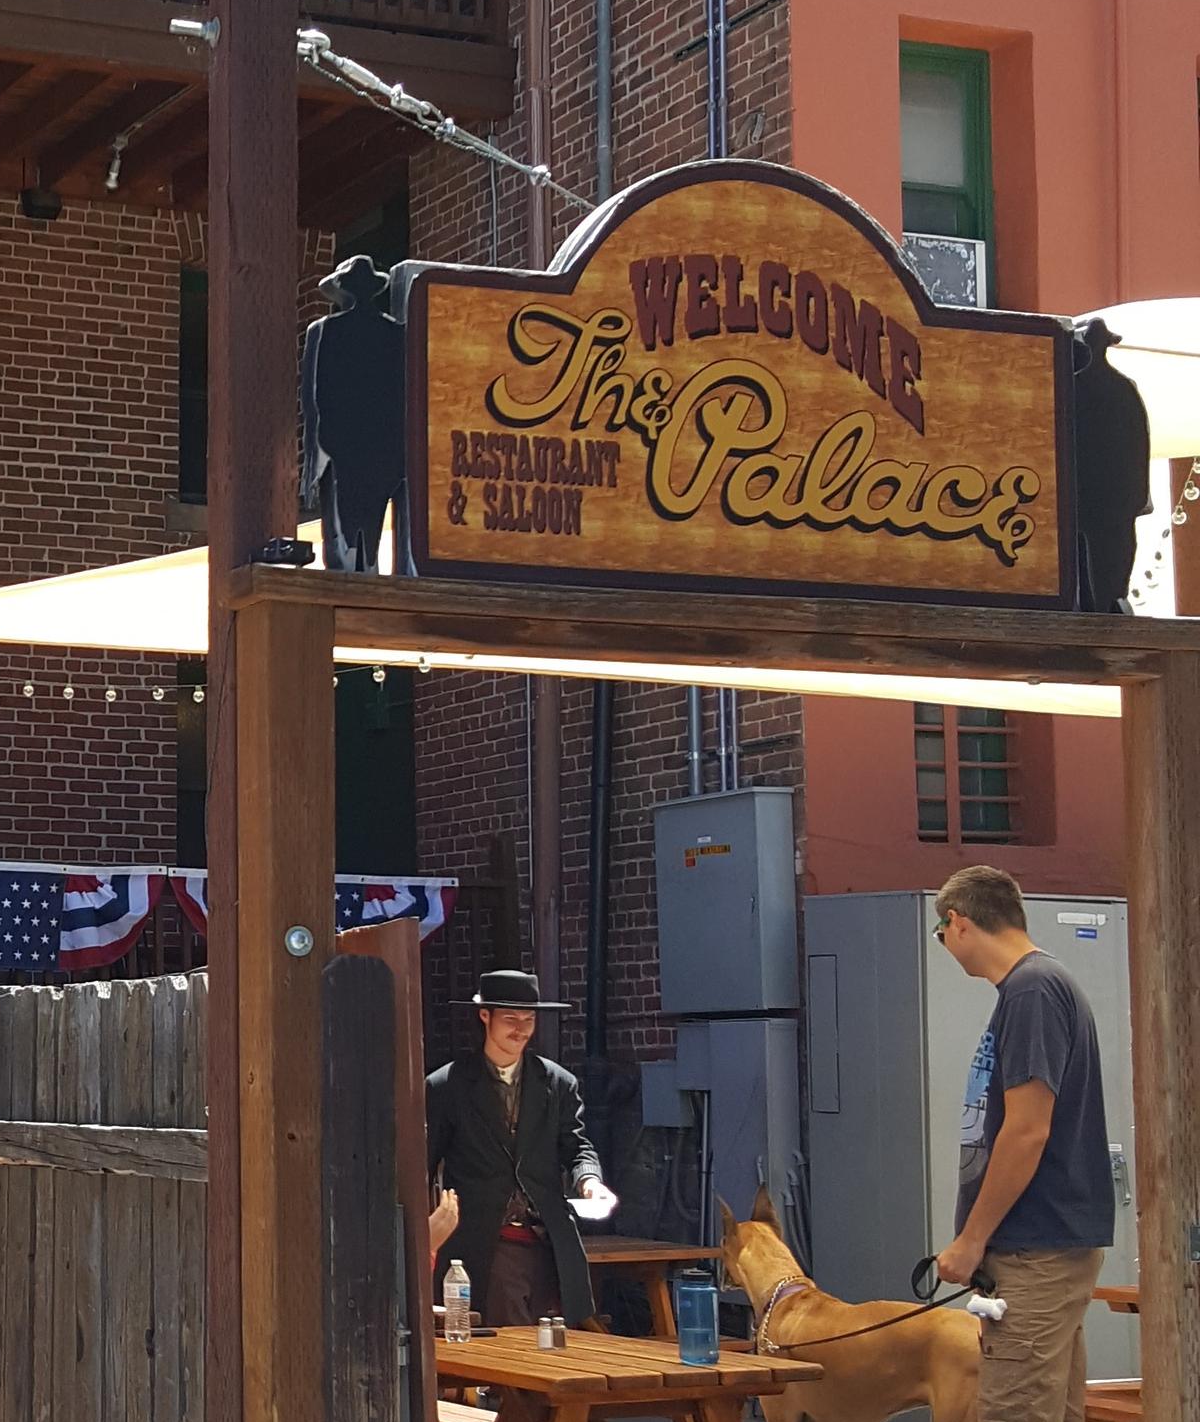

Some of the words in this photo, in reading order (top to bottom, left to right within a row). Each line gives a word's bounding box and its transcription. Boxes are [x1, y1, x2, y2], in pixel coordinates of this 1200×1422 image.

[629, 255, 925, 436] WELCOME
[450, 430, 620, 489] RESTAURANT
[485, 302, 671, 441] The
[645, 358, 1041, 567] Palace
[447, 489, 467, 527] &
[483, 485, 583, 536] SALOON
